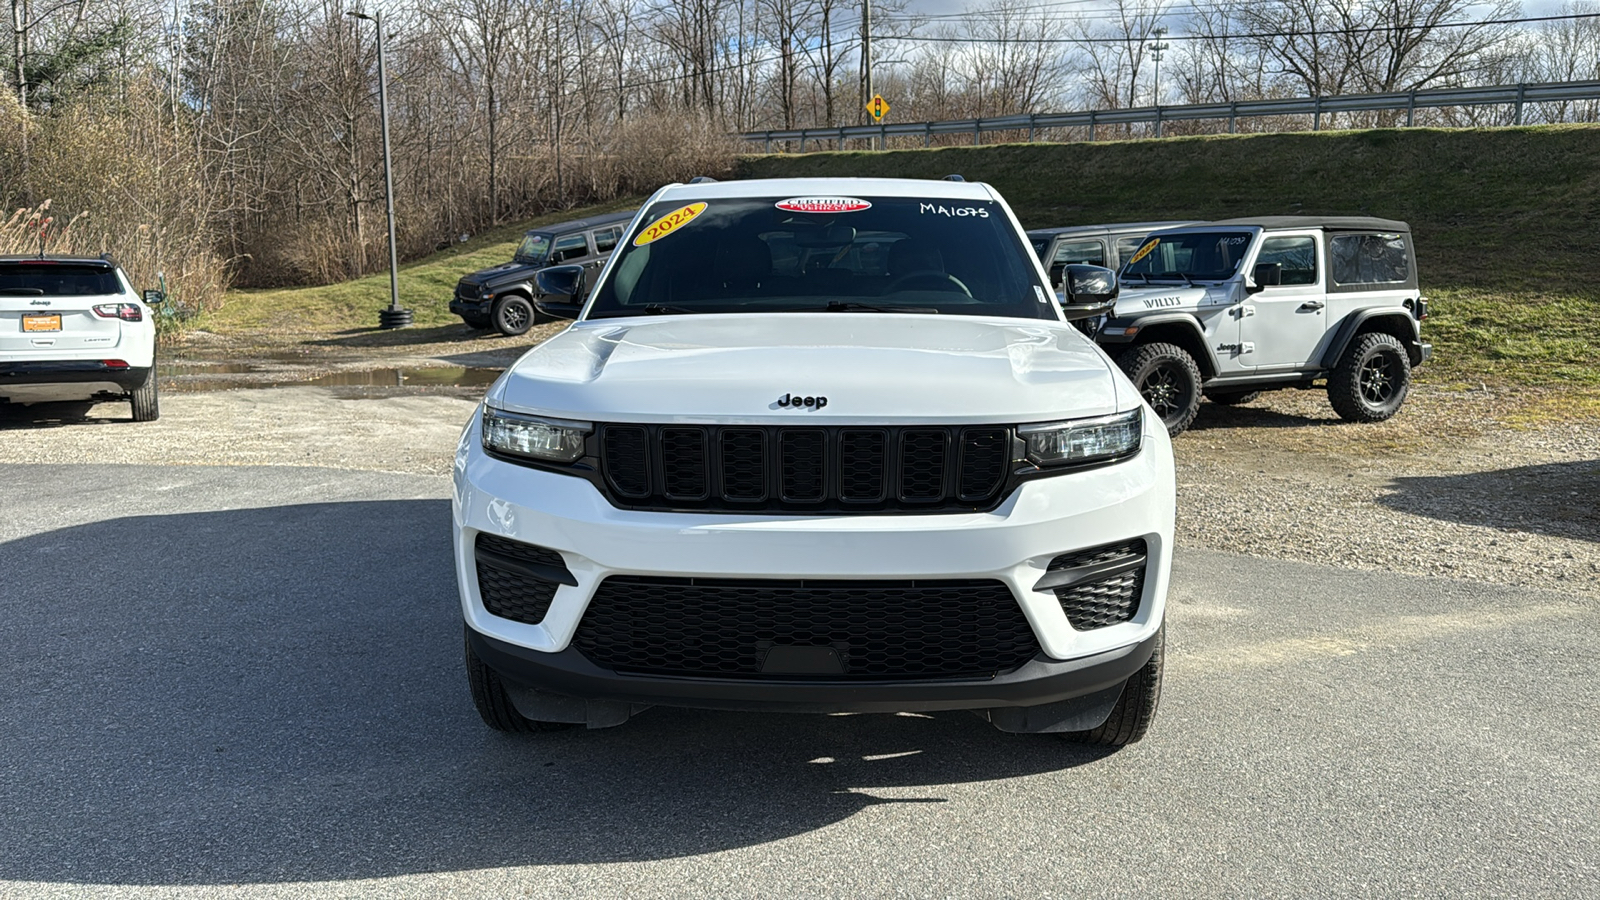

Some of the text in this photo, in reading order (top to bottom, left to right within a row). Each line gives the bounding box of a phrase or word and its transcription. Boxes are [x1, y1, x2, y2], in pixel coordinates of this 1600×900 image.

[919, 202, 989, 218] MA1075
[647, 207, 696, 239] 2024
[1143, 296, 1182, 308] WILLYS
[1216, 342, 1237, 352] Jeep
[777, 392, 828, 410] Jeep
